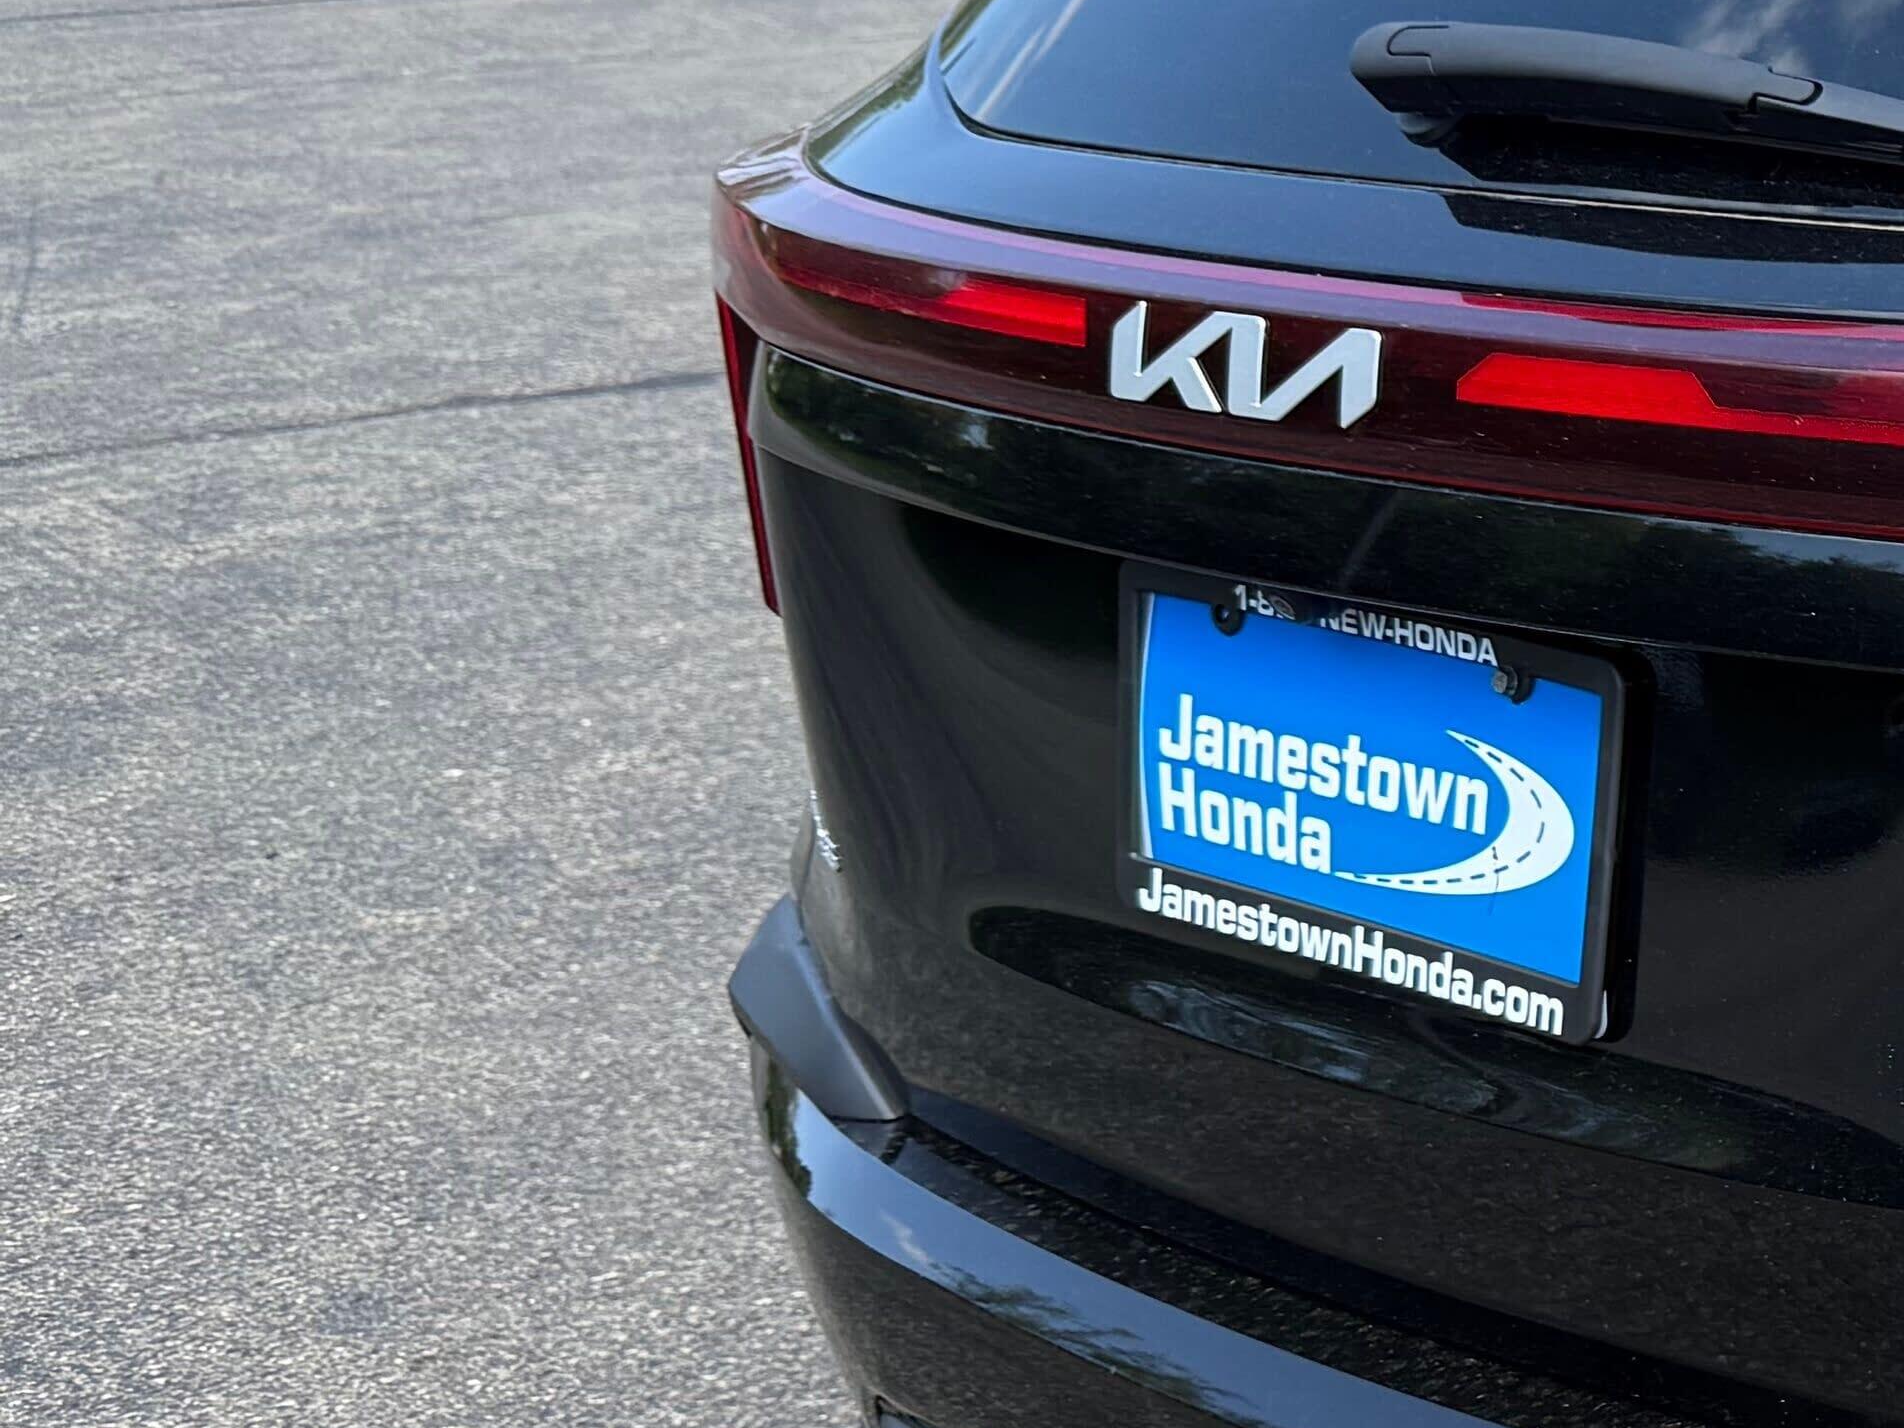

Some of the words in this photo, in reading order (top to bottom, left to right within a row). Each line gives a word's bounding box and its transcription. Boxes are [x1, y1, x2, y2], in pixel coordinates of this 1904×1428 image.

[1111, 301, 1382, 428] KIA
[1159, 694, 1488, 834] Jamestown
[1160, 762, 1332, 874] Honda
[1137, 867, 1564, 1035] JamestownHonda.com
